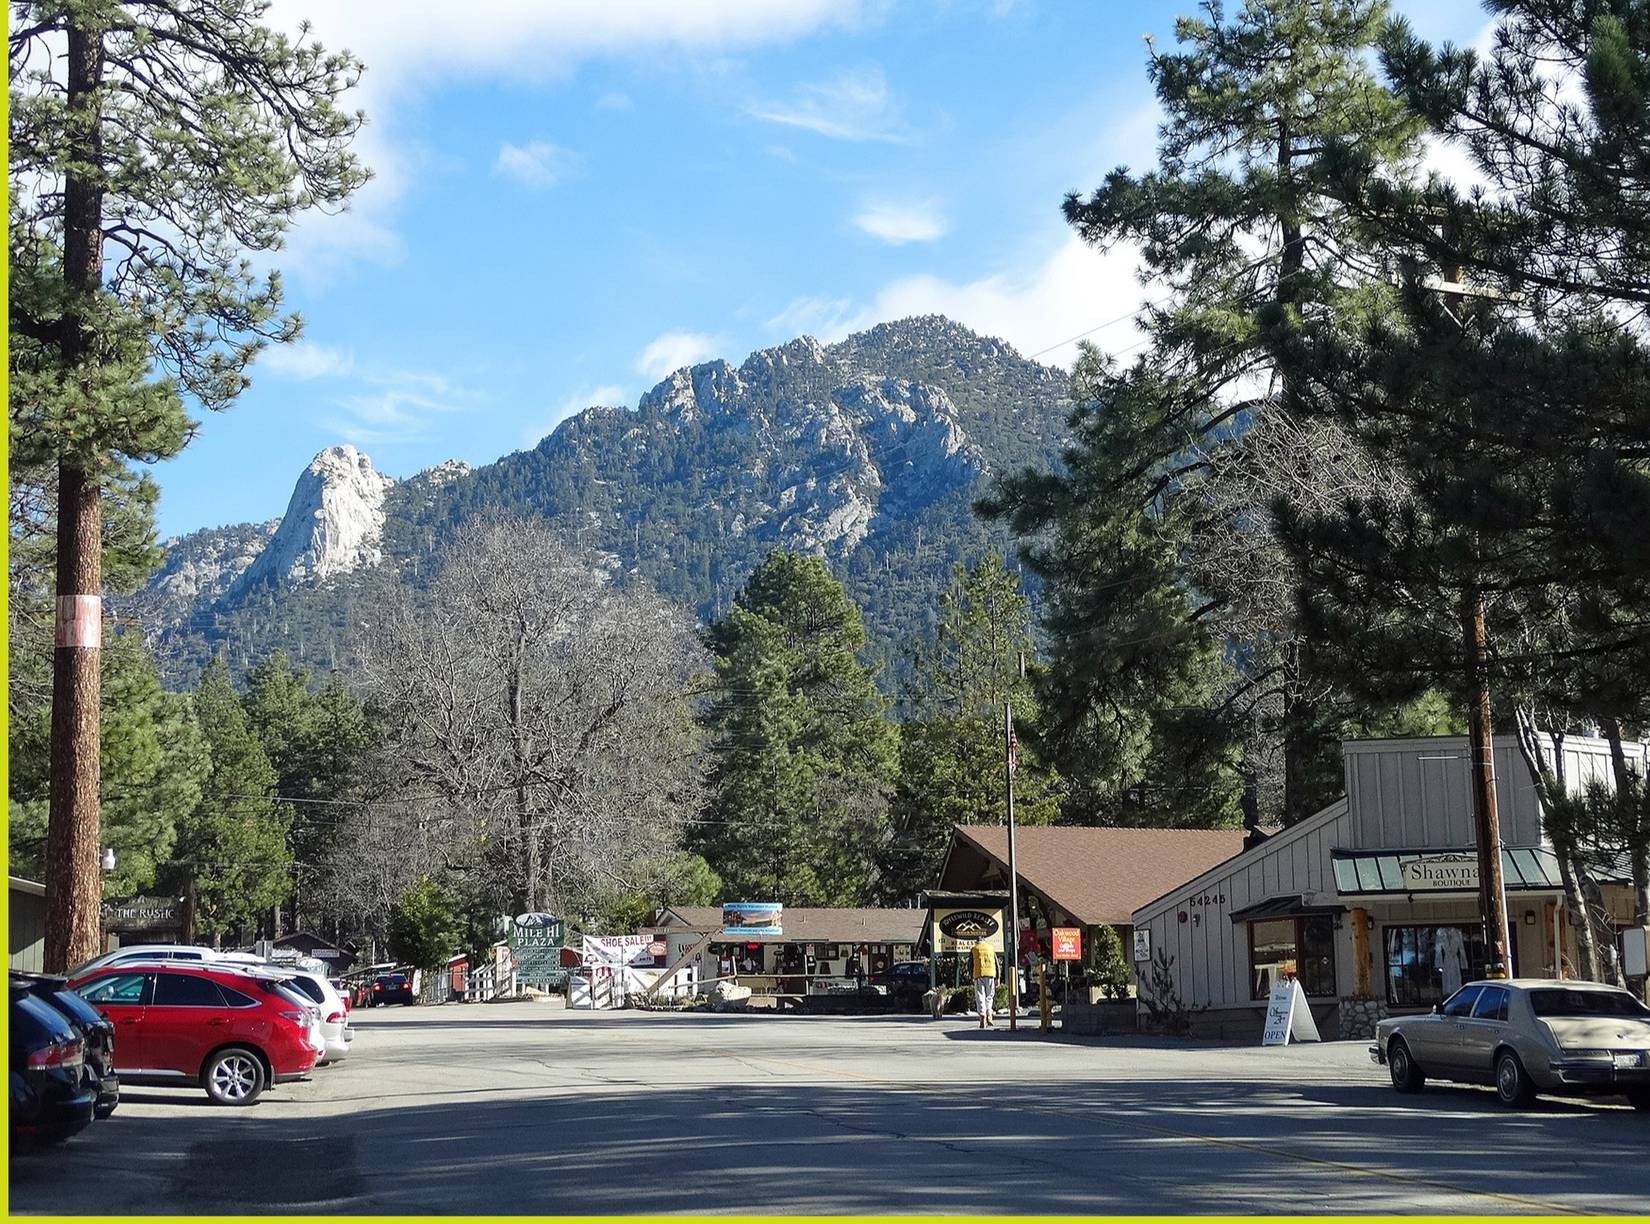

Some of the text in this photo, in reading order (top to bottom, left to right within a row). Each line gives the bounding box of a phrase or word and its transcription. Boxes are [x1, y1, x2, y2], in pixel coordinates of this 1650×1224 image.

[1411, 863, 1479, 880] Shawna
[1189, 895, 1226, 907] 54245
[117, 908, 174, 919] THE RUSTIC
[944, 912, 995, 927] IDYLLWILD REALTY
[513, 922, 560, 938] MILE HI
[517, 937, 555, 947] PLAZA
[600, 938, 624, 948] SHOE
[1264, 1031, 1286, 1040] OPEN
